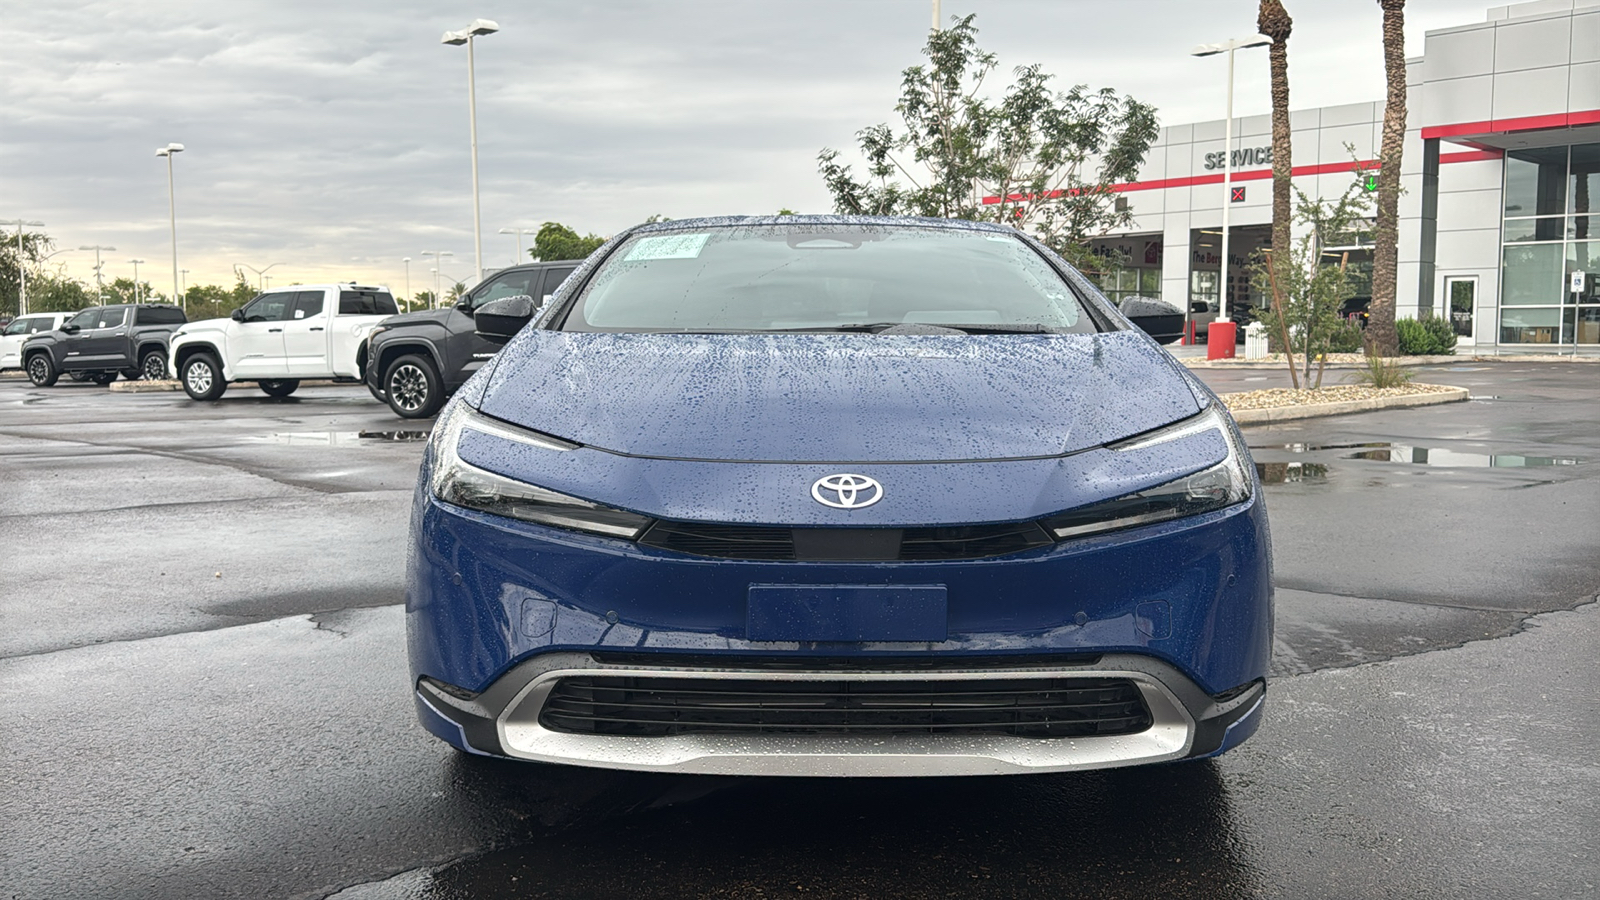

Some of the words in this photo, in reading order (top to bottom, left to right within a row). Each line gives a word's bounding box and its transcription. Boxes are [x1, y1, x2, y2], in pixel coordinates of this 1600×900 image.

[1204, 146, 1274, 170] SERVICE
[1100, 244, 1132, 258] Faly!
[1193, 250, 1205, 263] The
[1206, 252, 1223, 267] Berg
